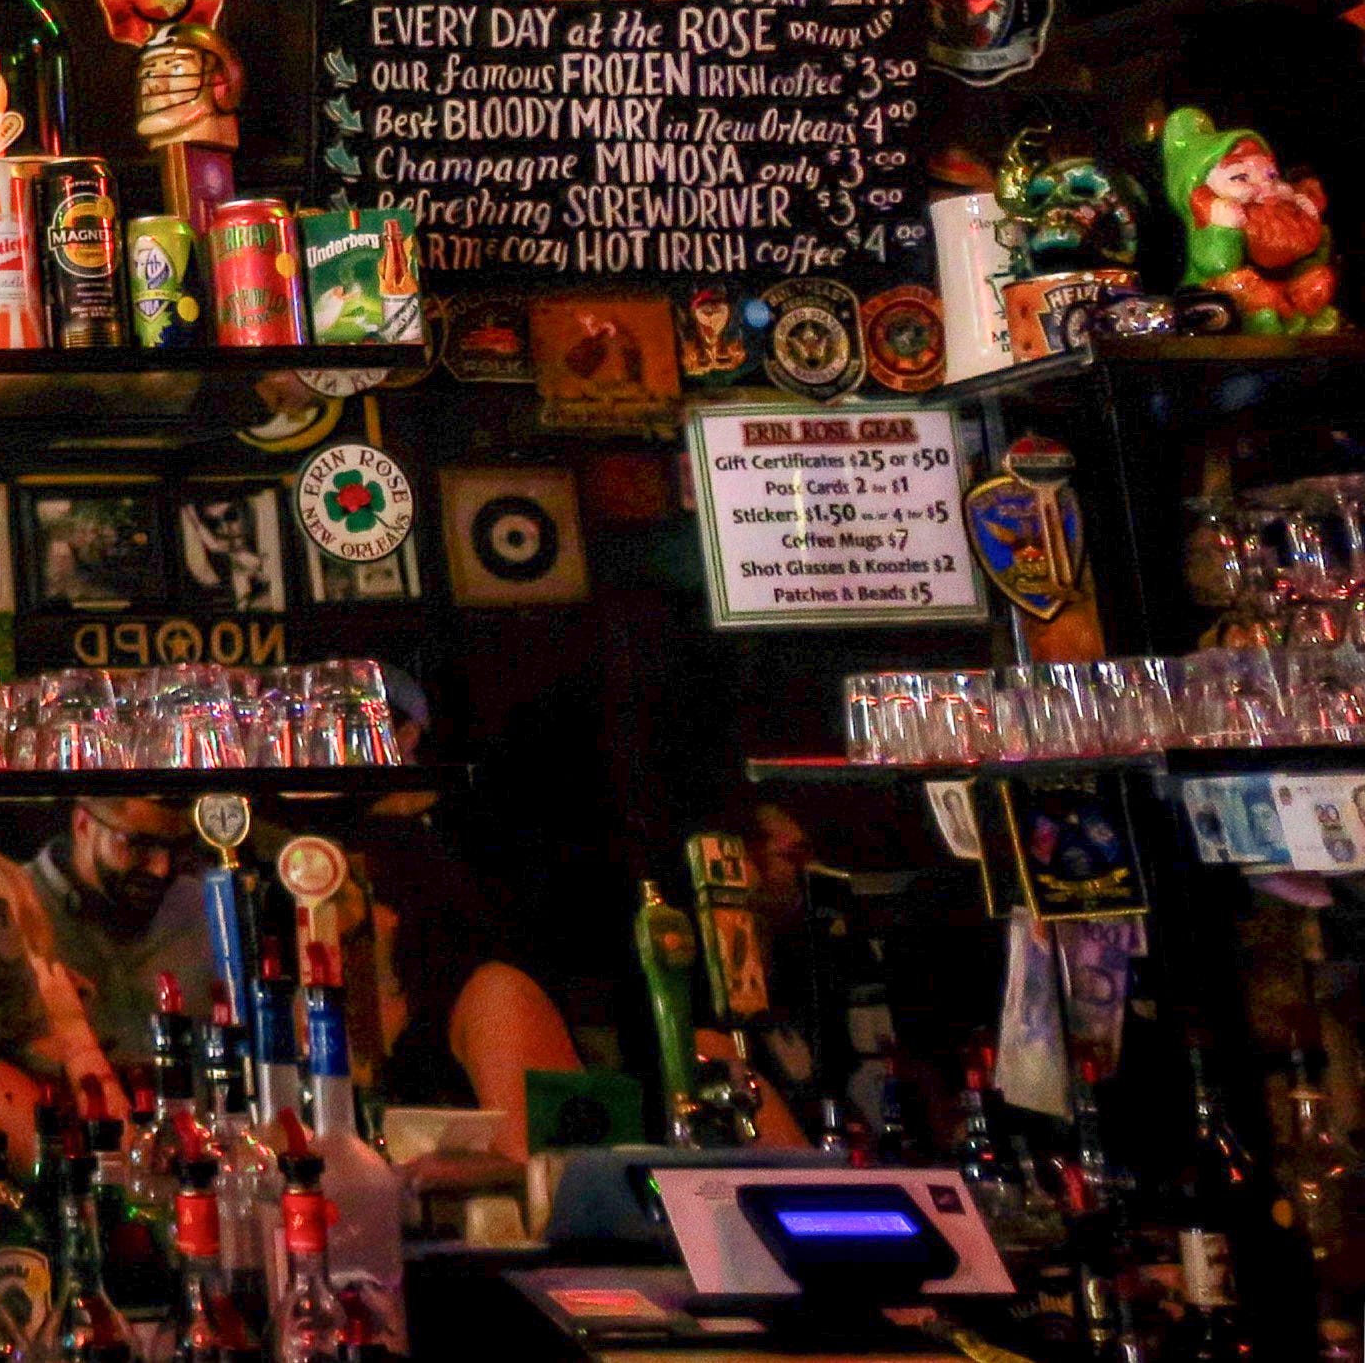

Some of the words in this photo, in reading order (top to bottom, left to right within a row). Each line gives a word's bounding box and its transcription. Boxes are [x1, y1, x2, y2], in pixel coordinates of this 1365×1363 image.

[372, 5, 479, 48] EVERY
[490, 5, 558, 48] DAY
[568, 14, 603, 50] at
[613, 10, 665, 49] the
[680, 6, 777, 58] ROSE
[788, 20, 864, 49] DRINK
[371, 59, 430, 93] OUR
[434, 53, 556, 96] famous
[562, 51, 691, 97] FROZEN
[698, 63, 768, 98] IRISH
[770, 61, 843, 98] coffee
[374, 103, 439, 139] Best
[442, 98, 564, 140] BLOODY
[570, 98, 664, 141] MARY
[663, 116, 689, 142] in
[693, 107, 756, 142] New
[374, 145, 579, 191] Champagne
[595, 141, 746, 188] MIMOSA
[757, 156, 822, 191] only
[563, 184, 792, 231] SCREWDRIVER
[305, 231, 381, 269] Underberg
[577, 230, 650, 274] HOT
[658, 231, 747, 274] IRISH
[754, 234, 847, 275] coffee
[745, 421, 793, 442] ERIN
[803, 421, 850, 441] ROSE
[859, 419, 917, 439] GEAR
[304, 449, 347, 498] ERIN
[359, 449, 410, 504] ROSE
[715, 454, 748, 472] Gift
[752, 452, 846, 470] Certificates
[850, 450, 884, 472] $25
[913, 448, 950, 469] $50
[806, 479, 849, 495] Cards
[804, 506, 857, 526] $1.50
[927, 500, 950, 524] $5
[839, 531, 885, 551] Mugs
[740, 559, 782, 578] Shot
[787, 559, 846, 577] Glasses
[866, 556, 930, 575] Koozies
[773, 585, 838, 604] Patches
[857, 583, 906, 602] Beads
